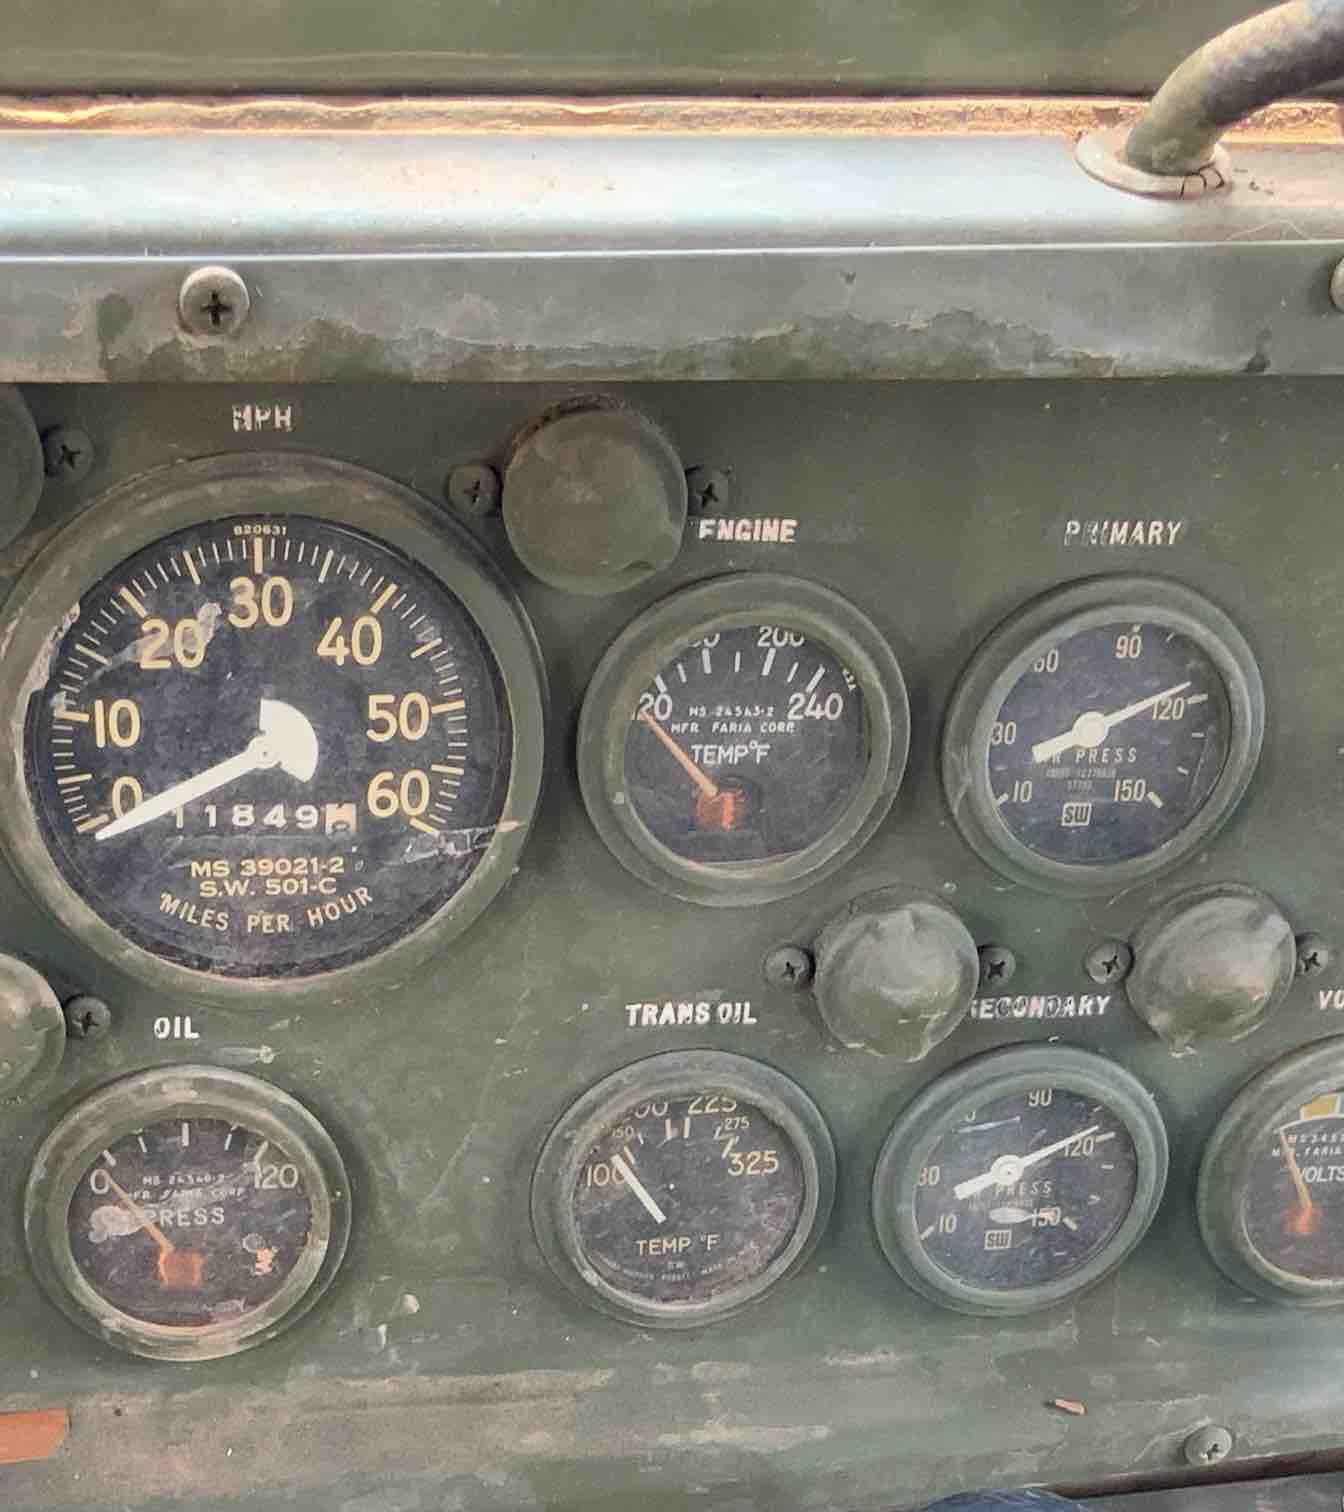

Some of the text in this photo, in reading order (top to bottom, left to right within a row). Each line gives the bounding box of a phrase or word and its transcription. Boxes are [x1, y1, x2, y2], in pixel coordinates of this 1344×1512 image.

[698, 518, 798, 543] ENGINE
[1064, 520, 1182, 546] PRIMARY
[228, 576, 293, 628] 30
[140, 617, 206, 669] 20
[317, 617, 383, 665] 40
[757, 625, 805, 648] 200
[1115, 635, 1142, 659] 90
[366, 692, 431, 742] 50
[632, 693, 674, 722] 20
[787, 692, 844, 721] 240
[1152, 696, 1185, 720] 120
[94, 699, 141, 748] 10
[712, 721, 753, 734] FARIA
[1075, 747, 1137, 764] PRESS
[111, 776, 143, 819] 0
[367, 771, 430, 818] 60
[1013, 779, 1033, 803] 10
[1115, 779, 1146, 803] 150
[190, 857, 345, 878] MS 39021-2
[265, 877, 337, 897] 501-C
[159, 887, 374, 934] MILES PER HOUR
[625, 1001, 757, 1027] TRANS OIL
[154, 1015, 200, 1040] OIL
[727, 1150, 779, 1176] 325
[90, 1168, 111, 1195] 0
[255, 1164, 299, 1190] 120
[938, 1215, 958, 1234] 10
[636, 1237, 691, 1256] TEMP
